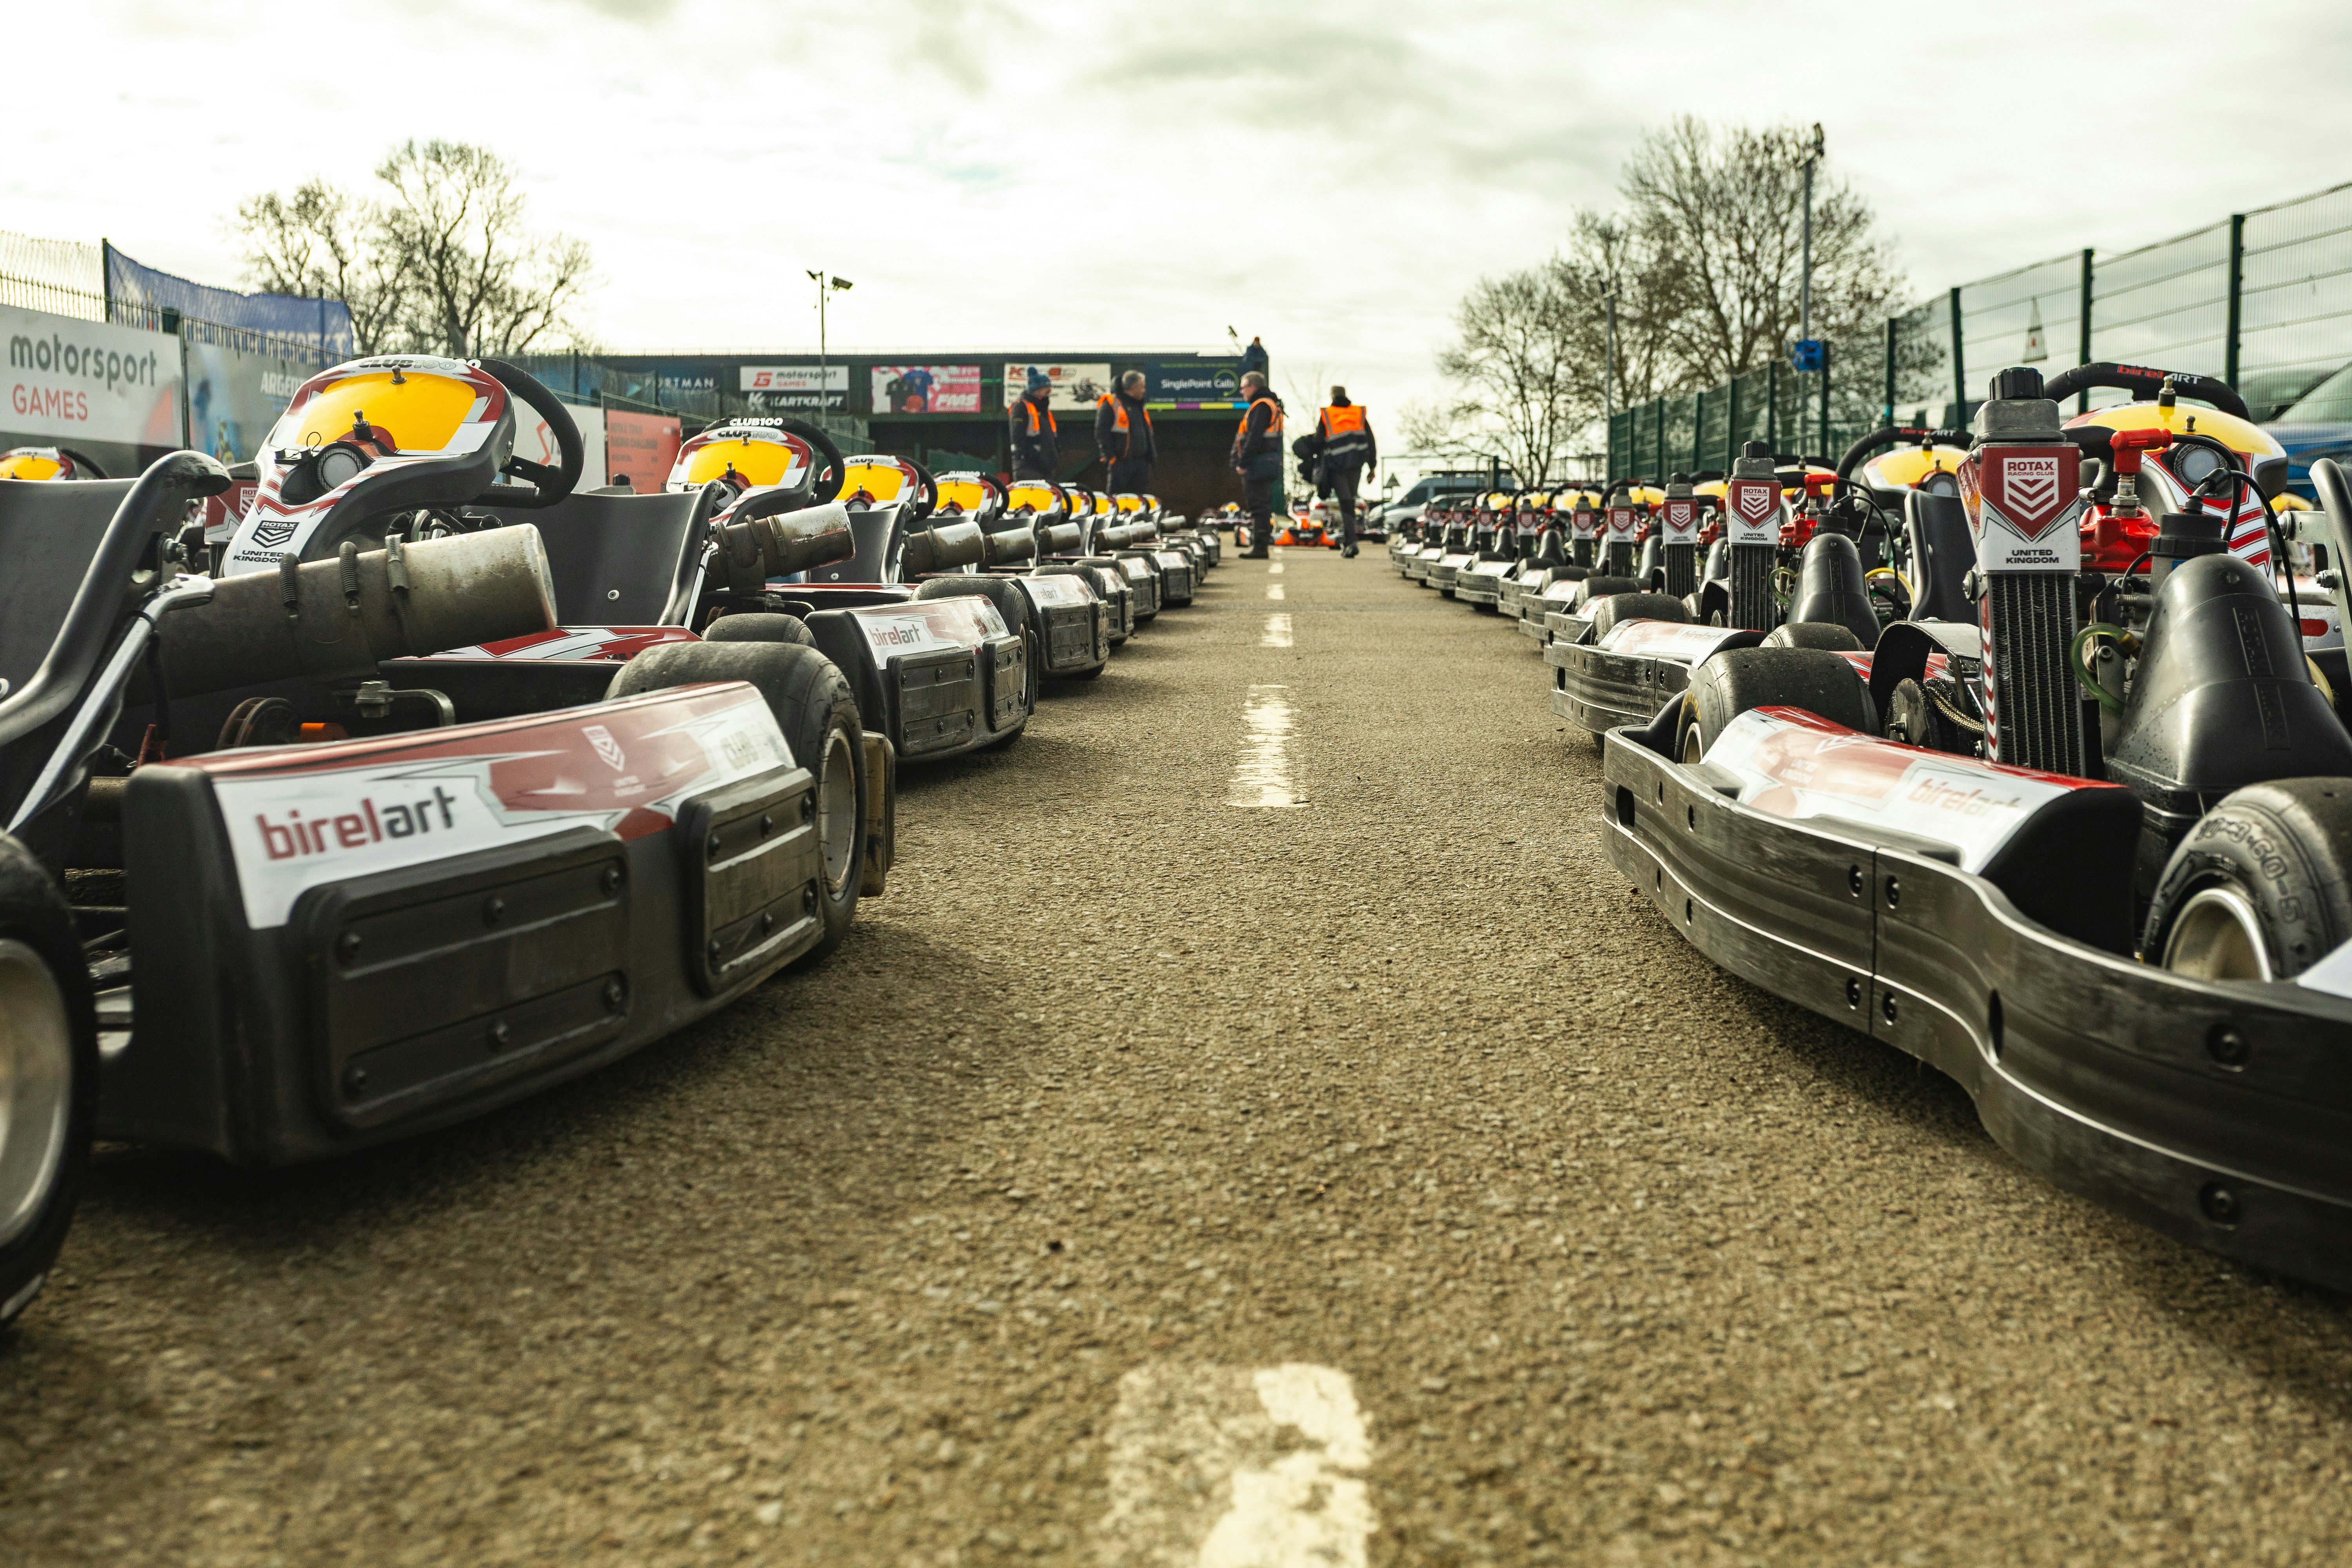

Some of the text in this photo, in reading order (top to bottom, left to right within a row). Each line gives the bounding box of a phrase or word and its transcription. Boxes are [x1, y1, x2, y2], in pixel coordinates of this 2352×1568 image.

[10, 332, 157, 391] motorsport
[358, 359, 456, 370] CLUB100
[776, 371, 836, 380] motorsport
[13, 383, 88, 422] GAMES
[729, 417, 783, 426] CLUB100
[717, 430, 779, 439] CLUB100
[2007, 461, 2054, 471] ROTAX
[868, 624, 921, 646] birelart
[255, 786, 456, 860] birelart
